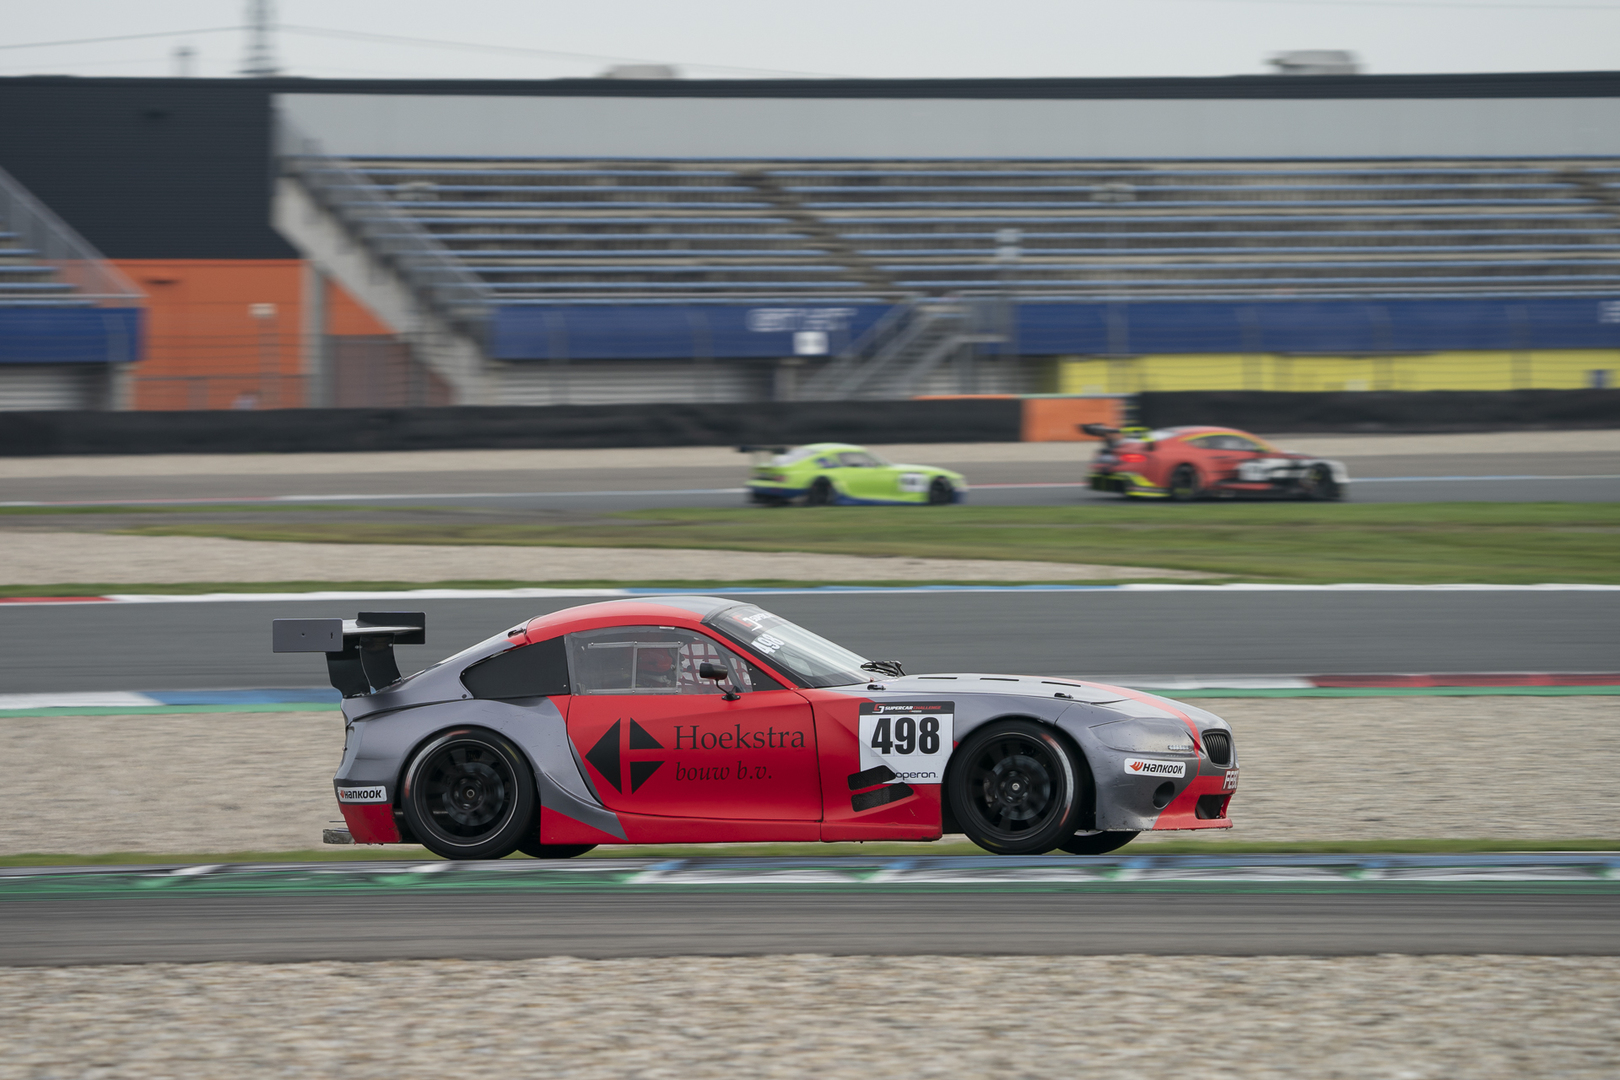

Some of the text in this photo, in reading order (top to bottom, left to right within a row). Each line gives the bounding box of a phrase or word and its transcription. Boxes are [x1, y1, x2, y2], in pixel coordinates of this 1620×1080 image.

[673, 723, 806, 750] Hoekstra
[871, 717, 940, 755] 498
[675, 760, 772, 781] bouw b.v.
